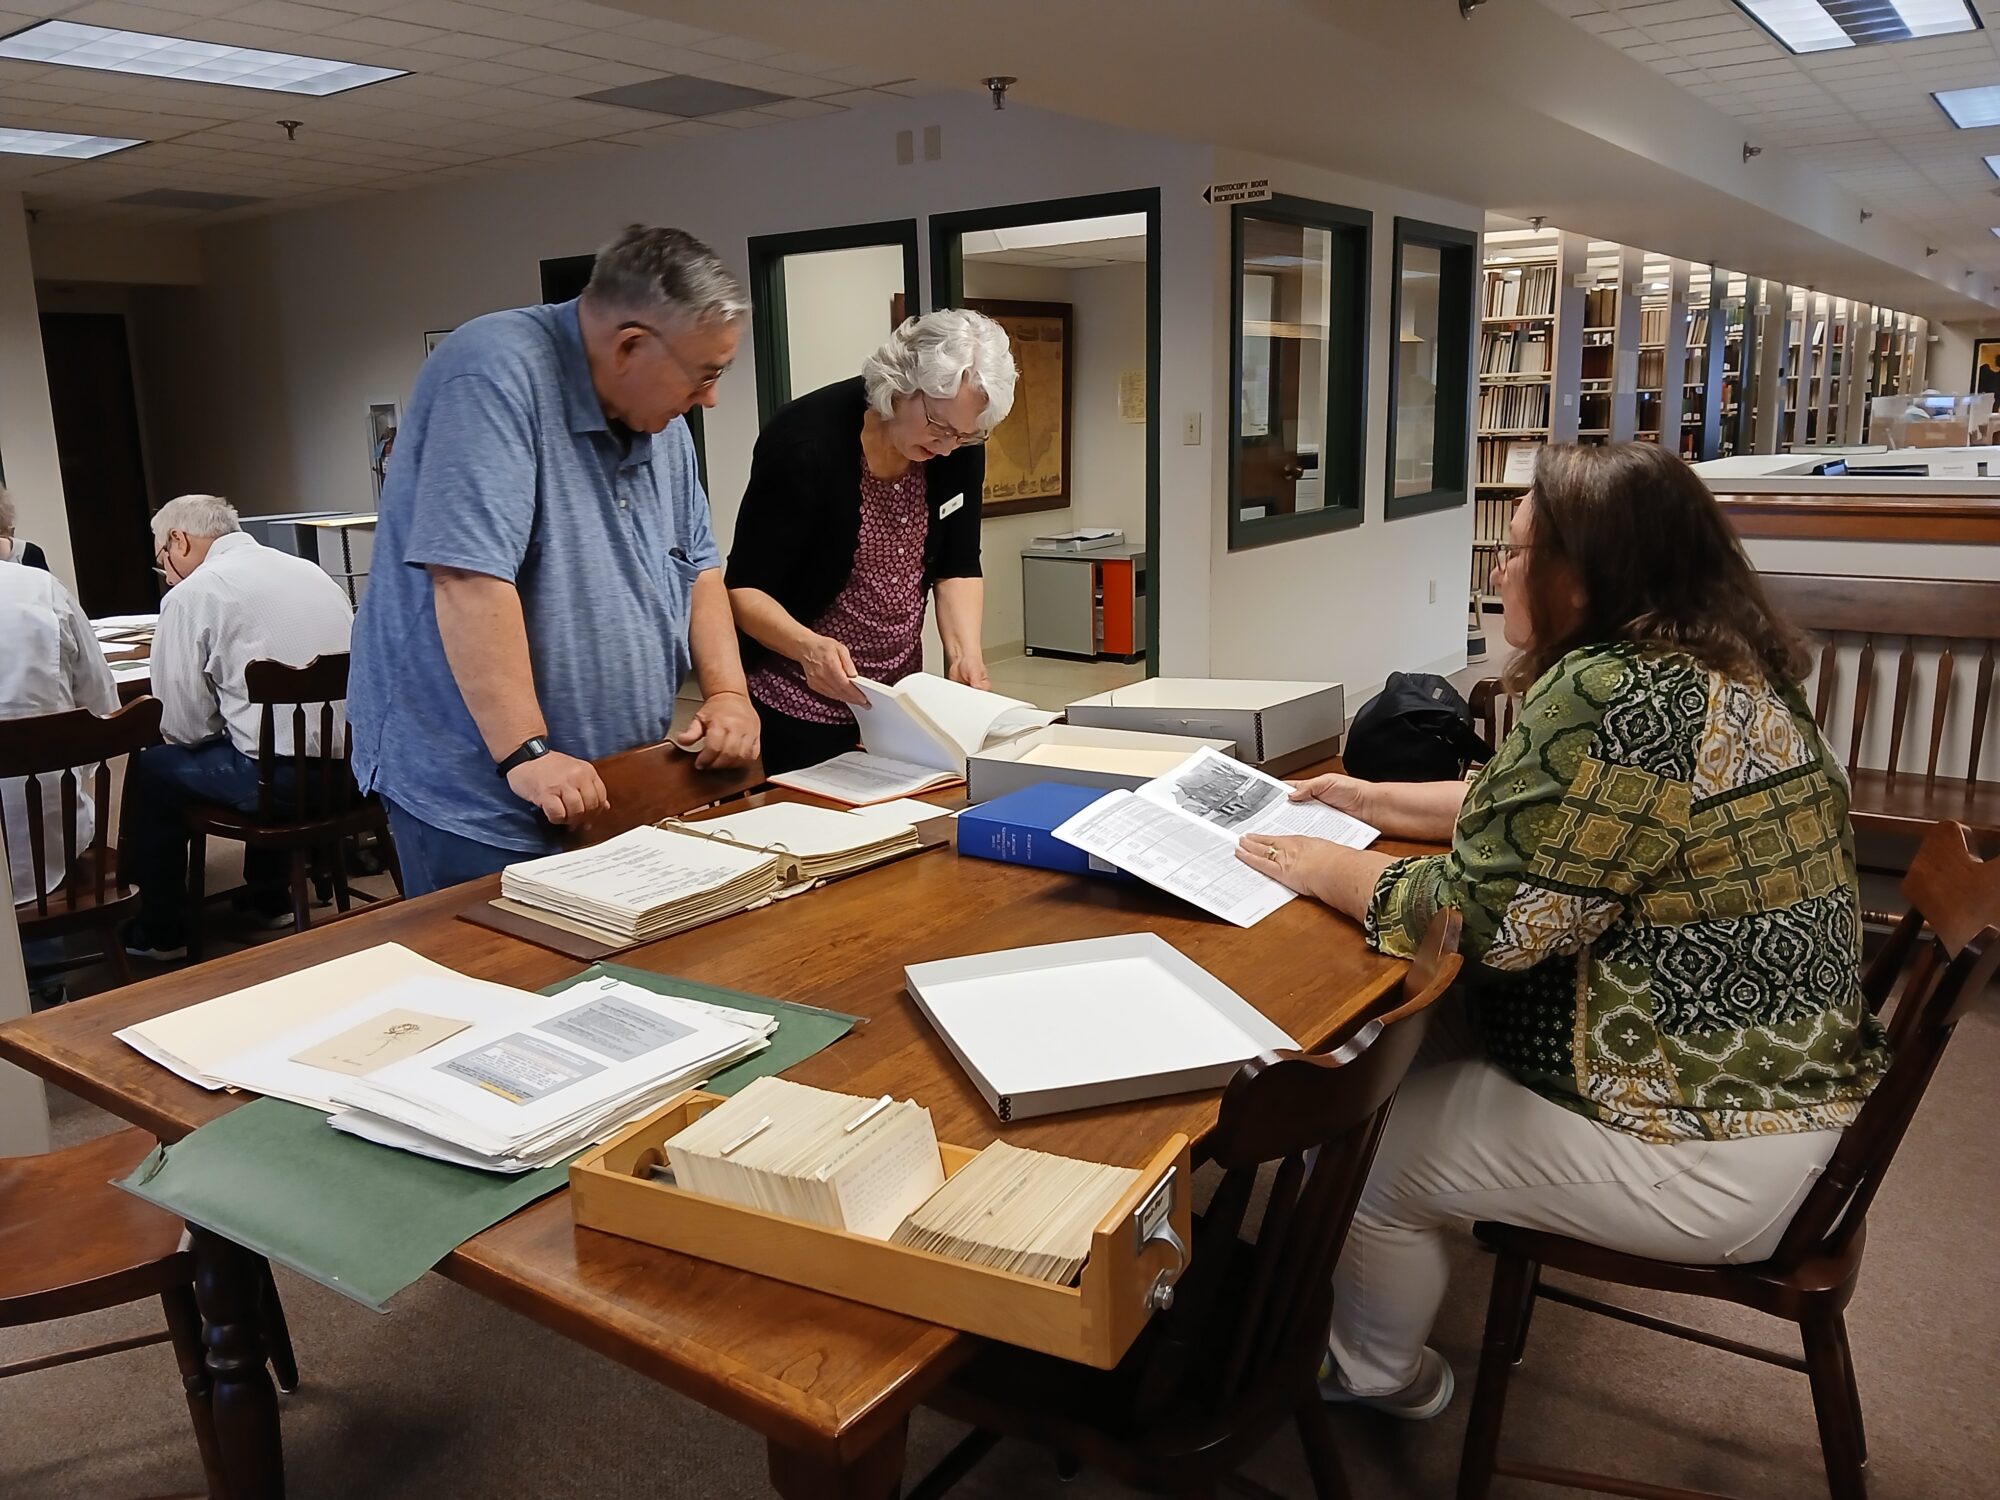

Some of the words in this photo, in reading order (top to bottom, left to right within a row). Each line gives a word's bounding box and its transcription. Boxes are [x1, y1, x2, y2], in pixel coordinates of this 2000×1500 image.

[1214, 182, 1248, 192] PHOTOCOPY
[1251, 179, 1268, 188] ROOM
[1214, 192, 1245, 202] MICROFILM
[1248, 190, 1265, 198] ROOM
